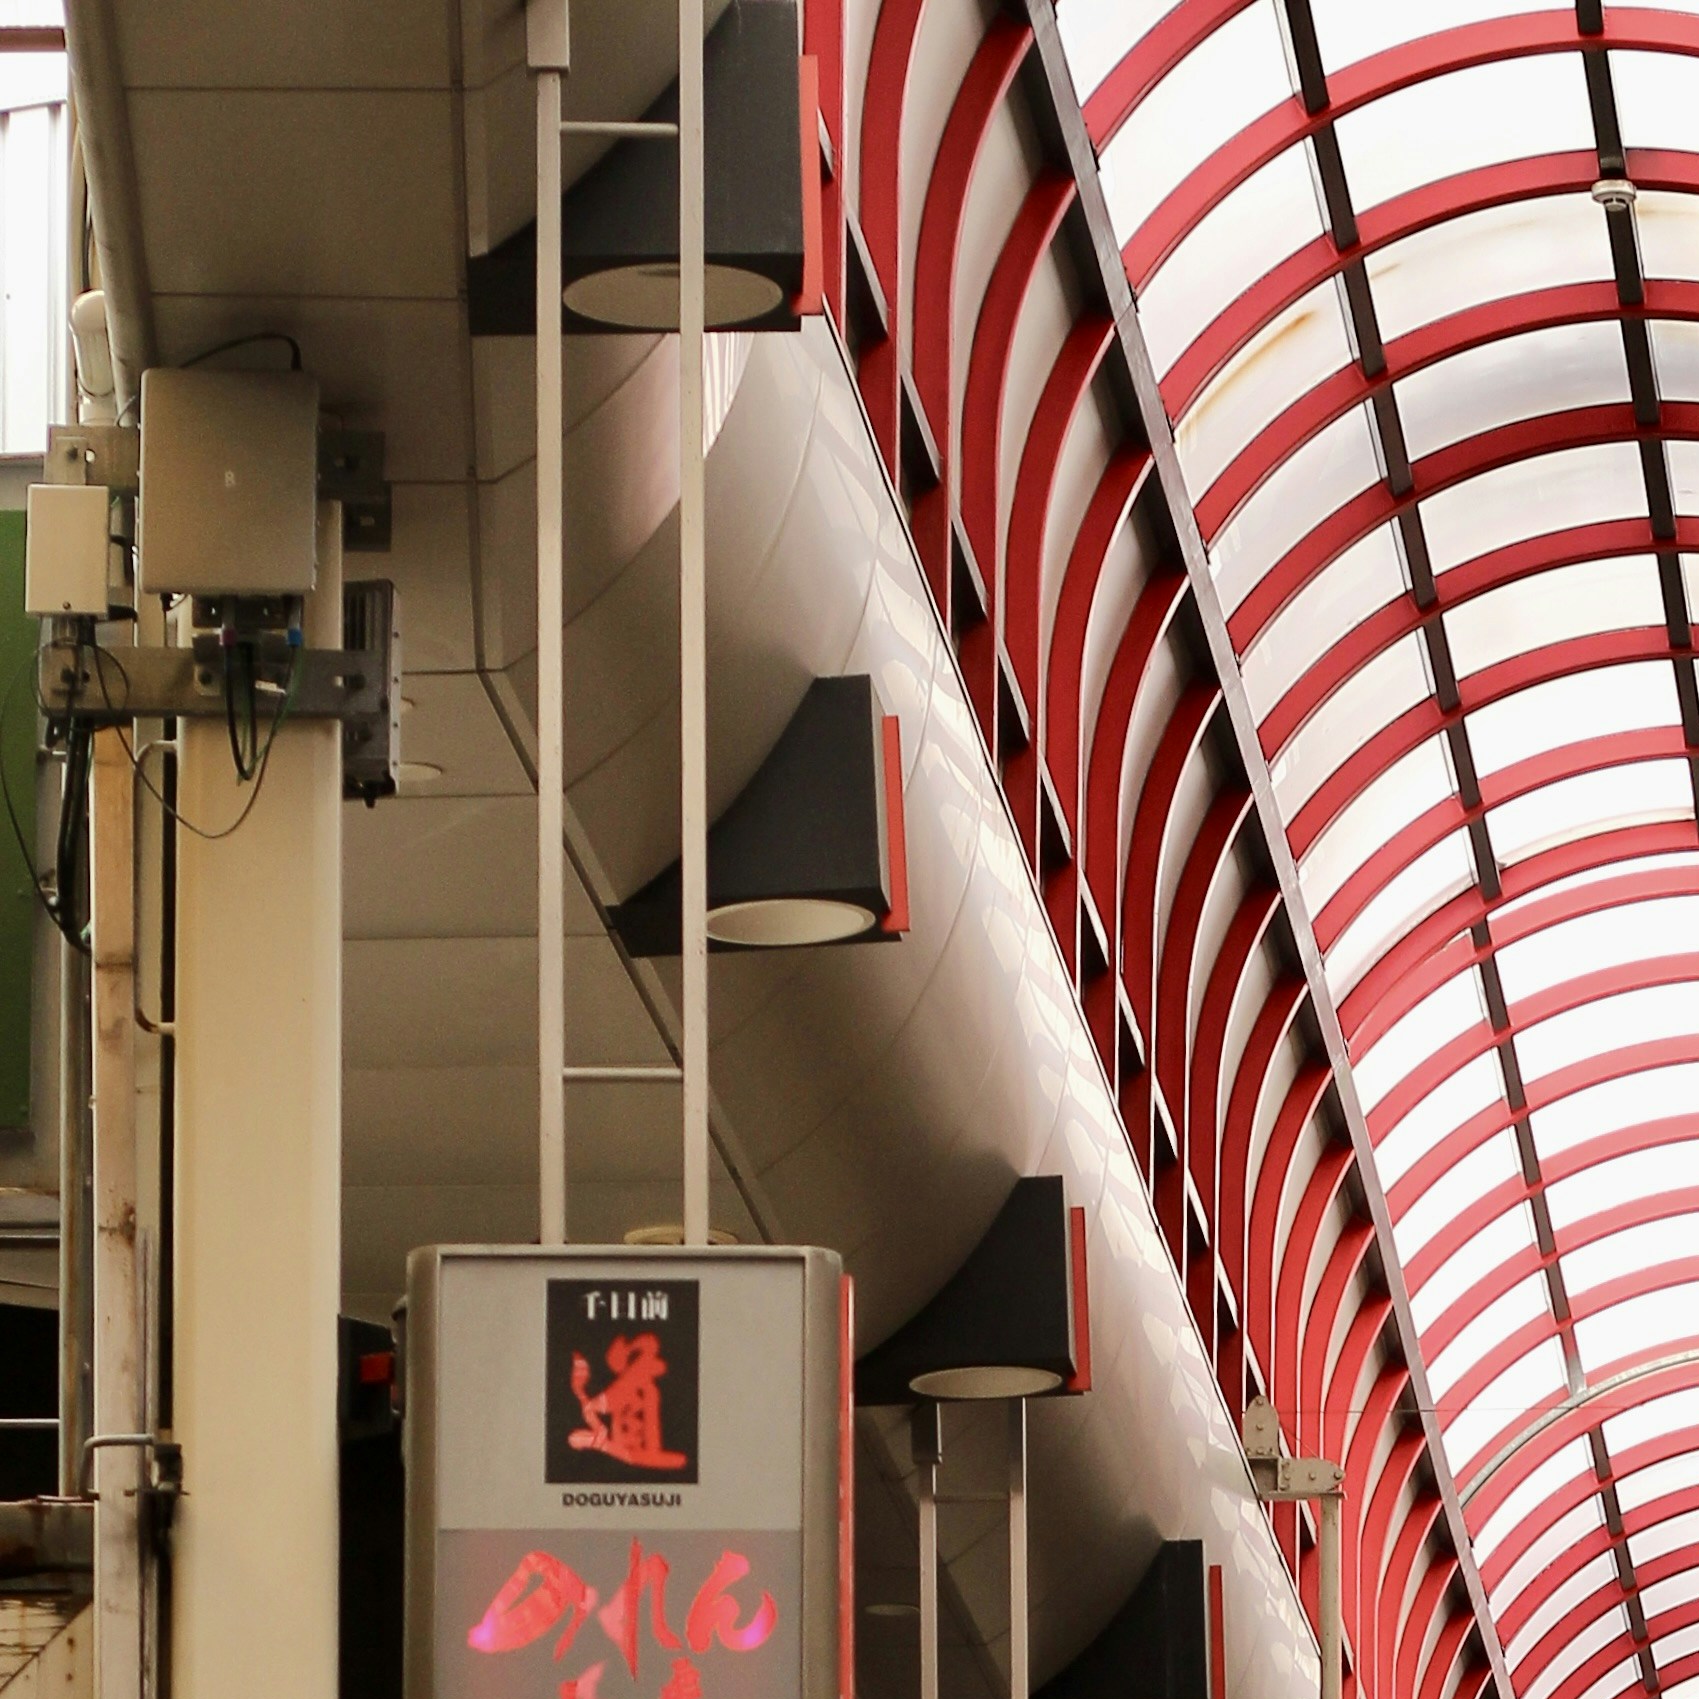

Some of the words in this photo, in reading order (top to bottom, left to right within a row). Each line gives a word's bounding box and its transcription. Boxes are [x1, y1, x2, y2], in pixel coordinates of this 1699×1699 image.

[586, 1290, 669, 1322] 千日前
[561, 1492, 682, 1508] DOGUYASUJI
[467, 1536, 778, 1682] のれん
